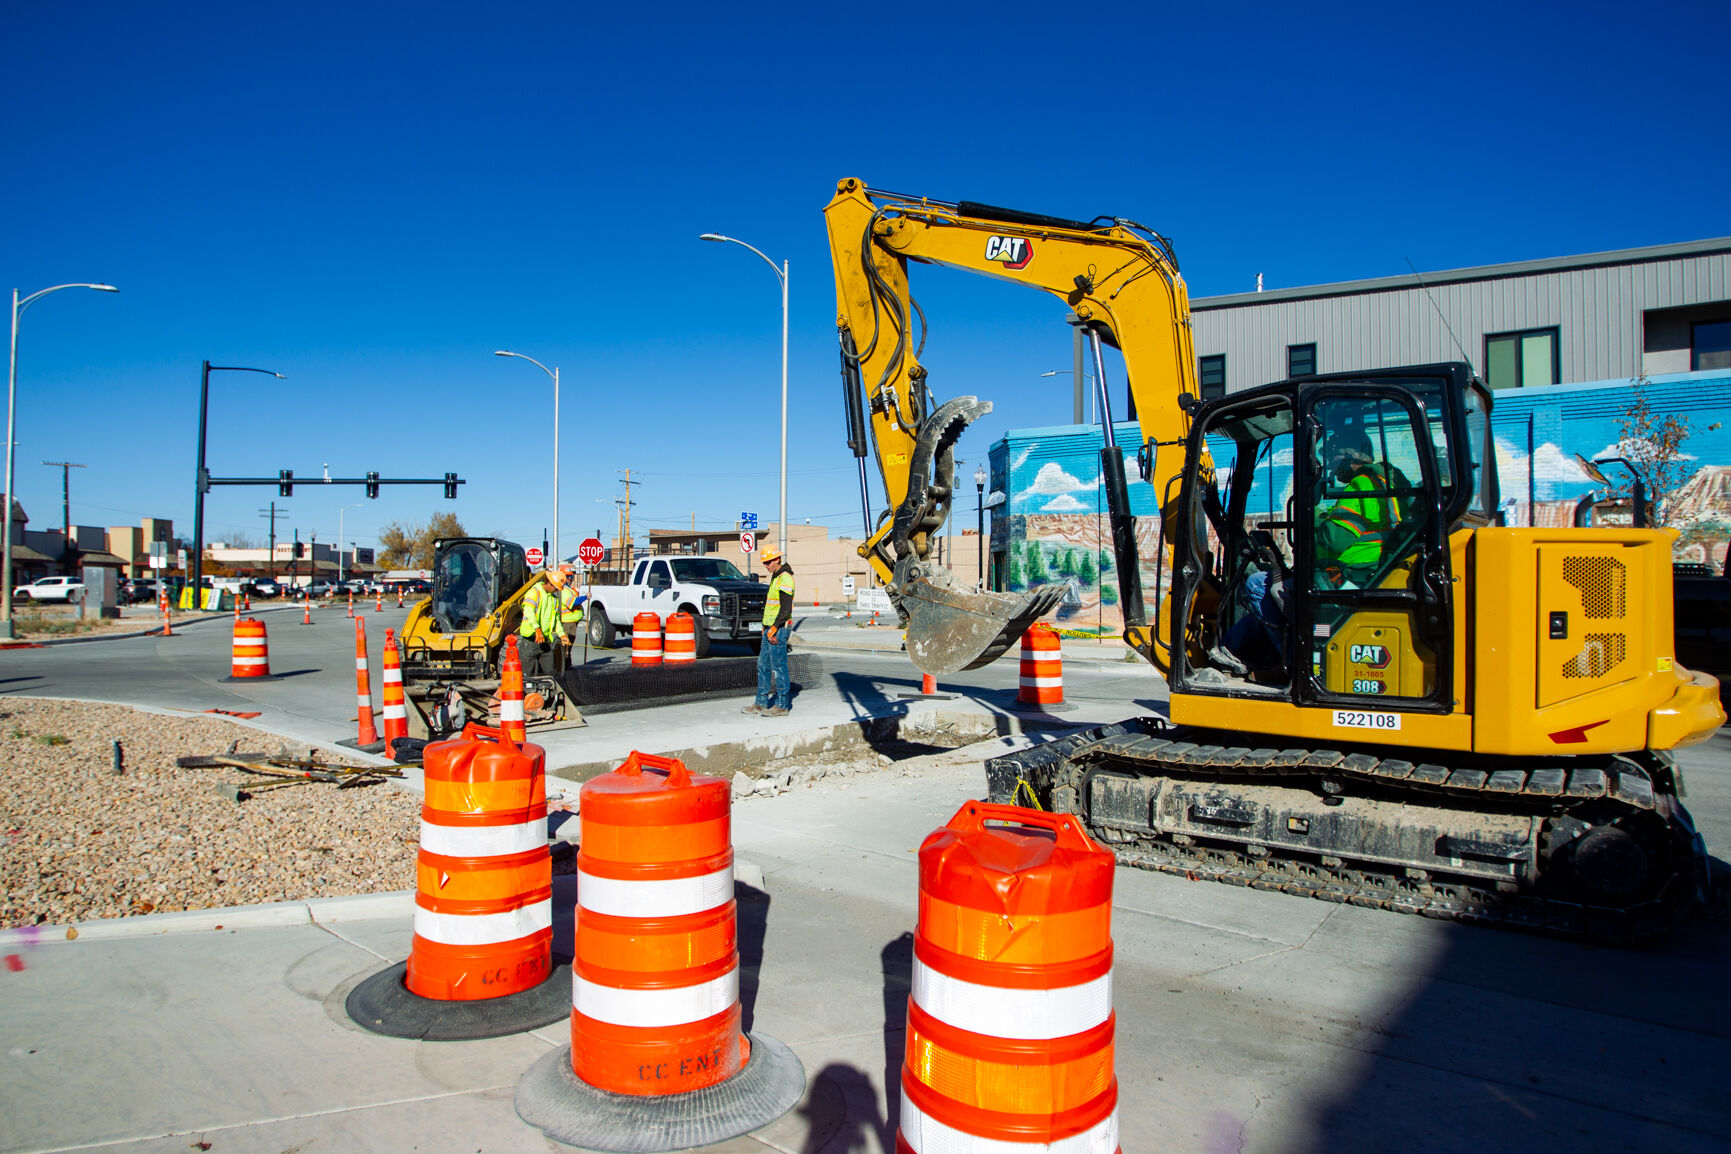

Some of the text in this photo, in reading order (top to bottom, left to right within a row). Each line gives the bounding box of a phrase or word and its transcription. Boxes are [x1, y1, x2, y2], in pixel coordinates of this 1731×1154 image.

[985, 235, 1025, 262] CAT
[580, 546, 603, 557] STOP
[1066, 630, 1092, 638] CAUTION
[1350, 644, 1382, 664] CAT
[1354, 670, 1385, 678] 31-1005
[1353, 679, 1379, 693] 308
[1337, 712, 1395, 728] 522108
[482, 967, 508, 984] CC
[638, 1049, 721, 1080] CC ENT
